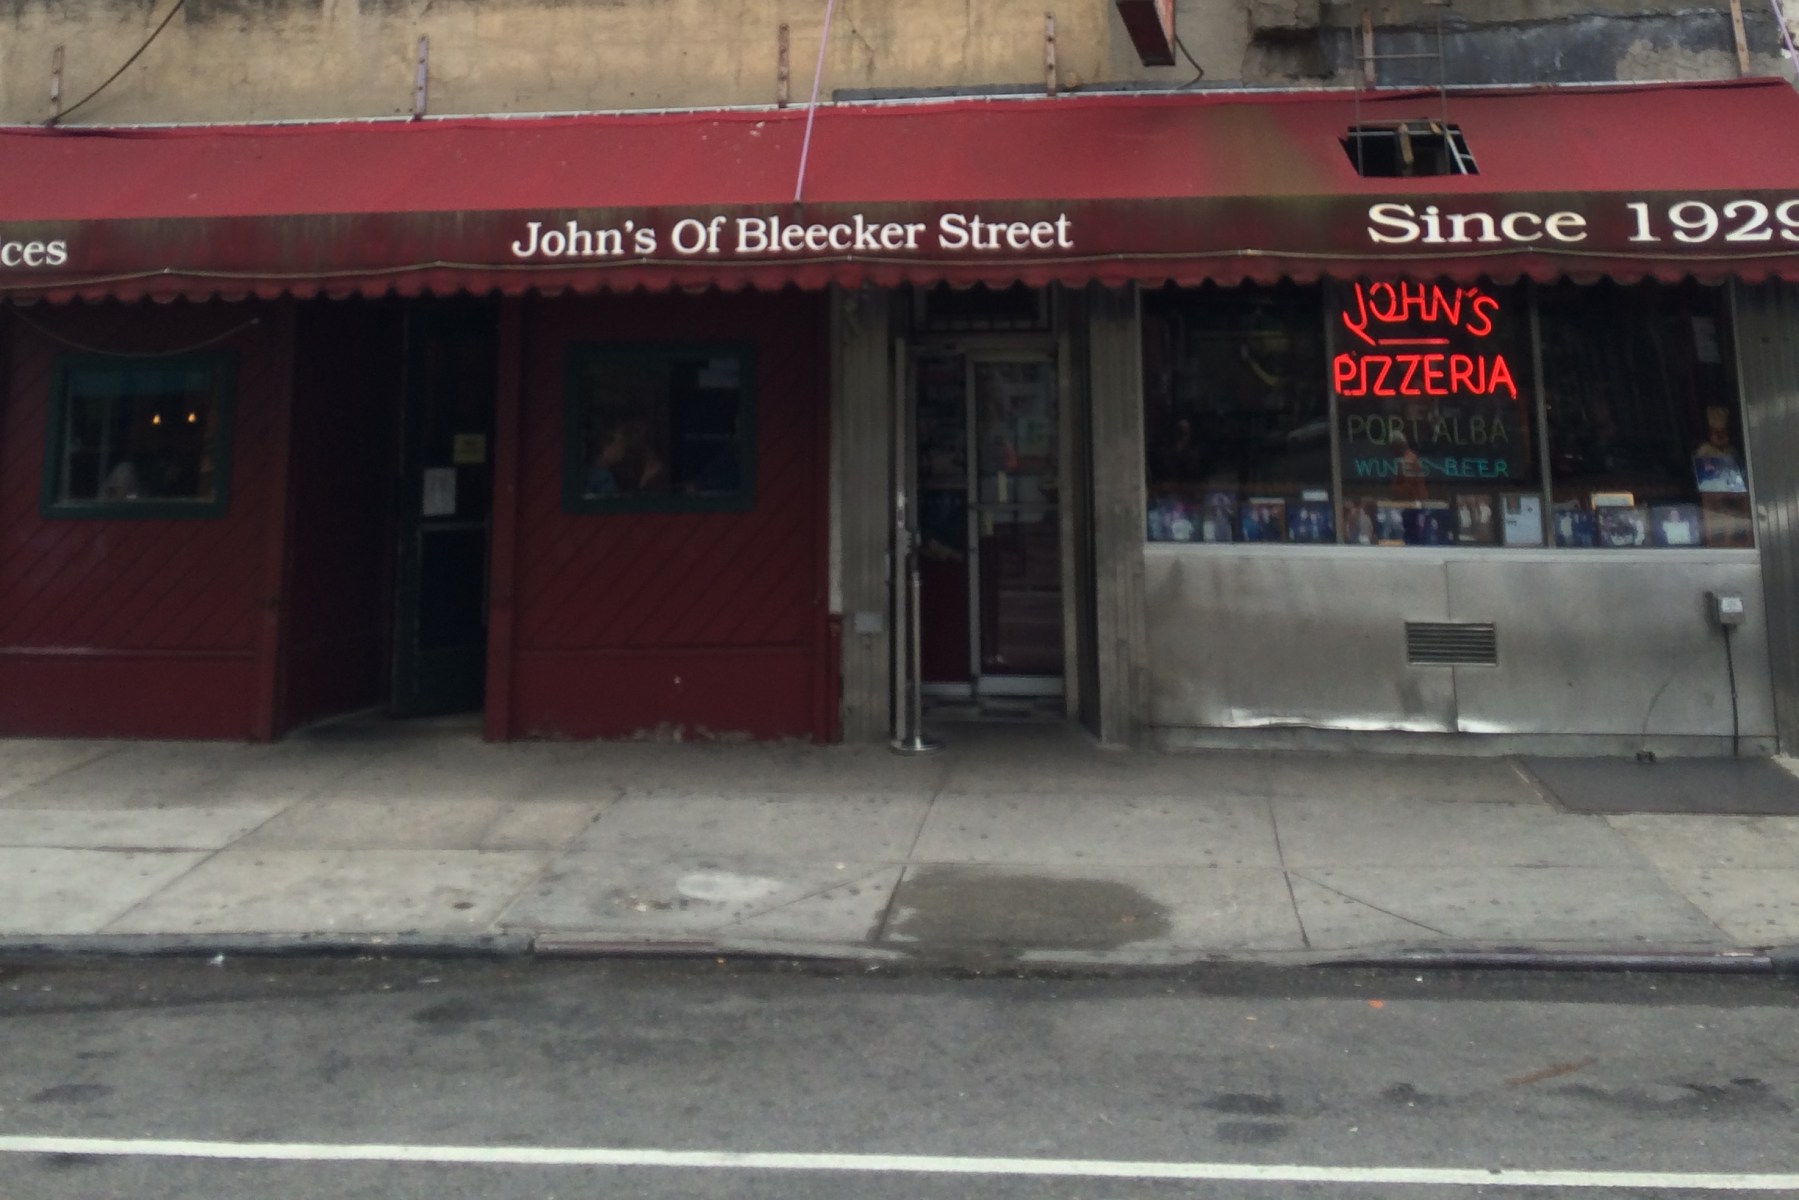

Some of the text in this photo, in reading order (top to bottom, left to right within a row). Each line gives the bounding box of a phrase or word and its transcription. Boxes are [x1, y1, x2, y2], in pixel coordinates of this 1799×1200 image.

[511, 212, 1074, 257] John's Of Bleecker Street
[1367, 202, 1588, 244] Since
[0, 235, 67, 267] ces
[1341, 280, 1500, 343] JOHN'S
[1333, 352, 1518, 400] PIZZERIA
[1347, 413, 1509, 447] PORT ALBA
